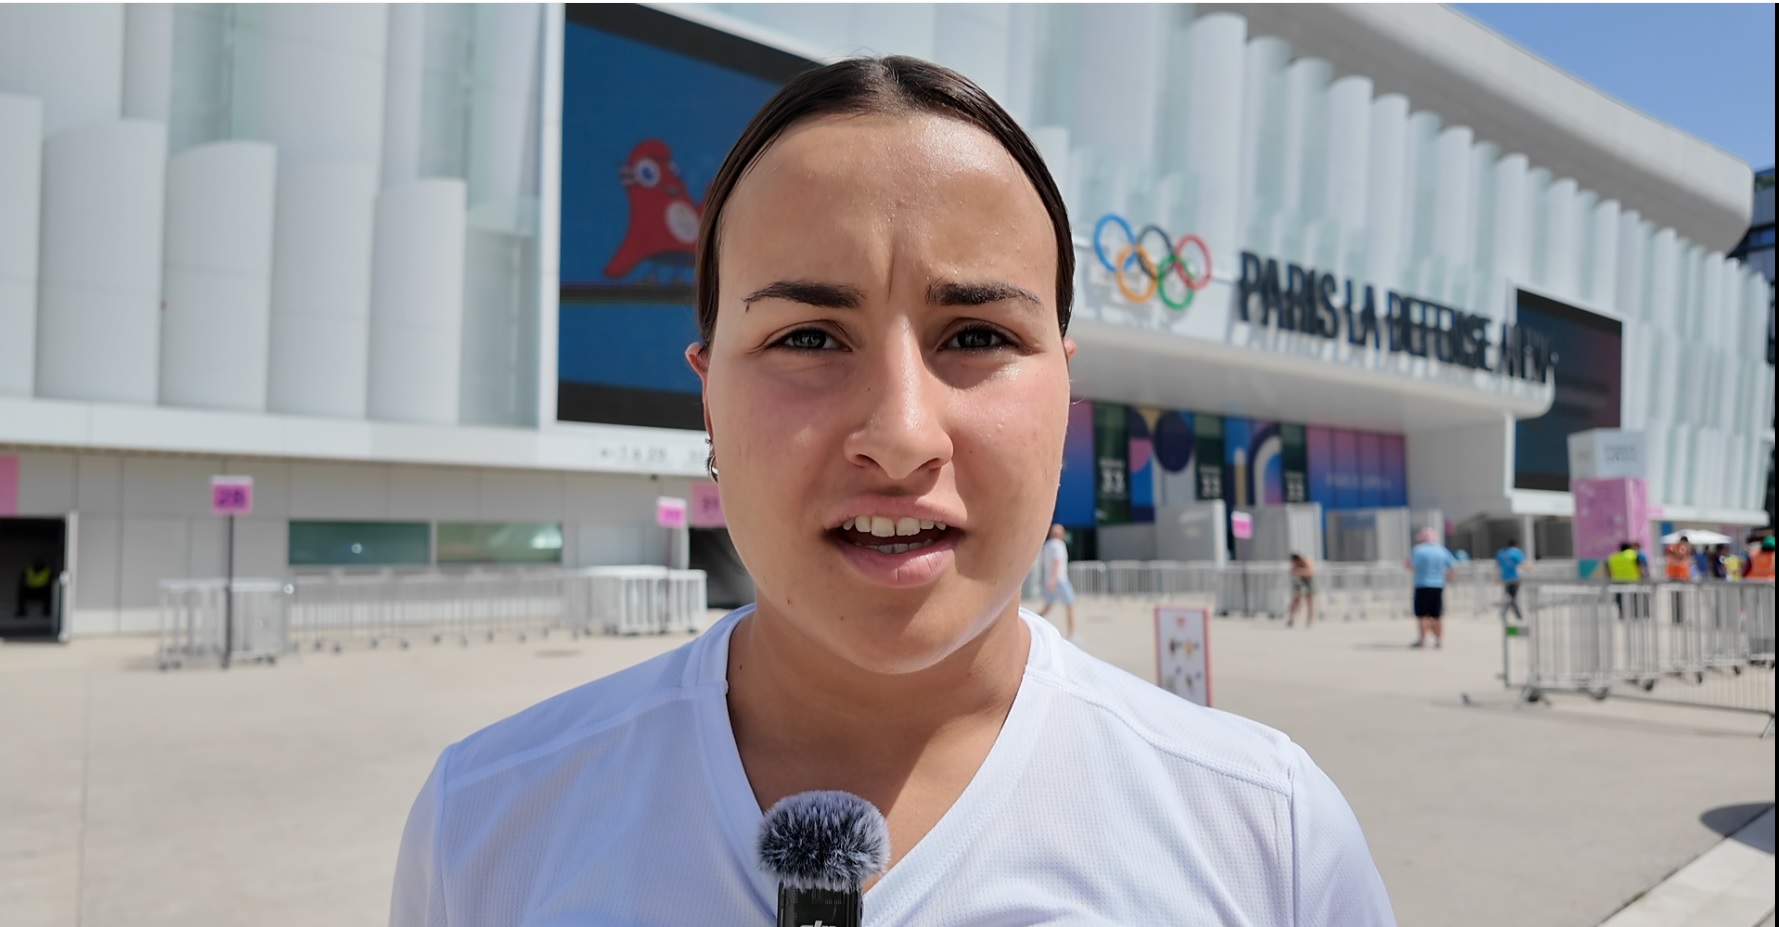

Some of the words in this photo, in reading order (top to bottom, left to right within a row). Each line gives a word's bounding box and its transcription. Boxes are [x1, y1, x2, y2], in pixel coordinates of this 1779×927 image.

[1238, 250, 1338, 340] PARIS
[1345, 279, 1381, 350] LA
[1388, 287, 1494, 373] DEFENSE
